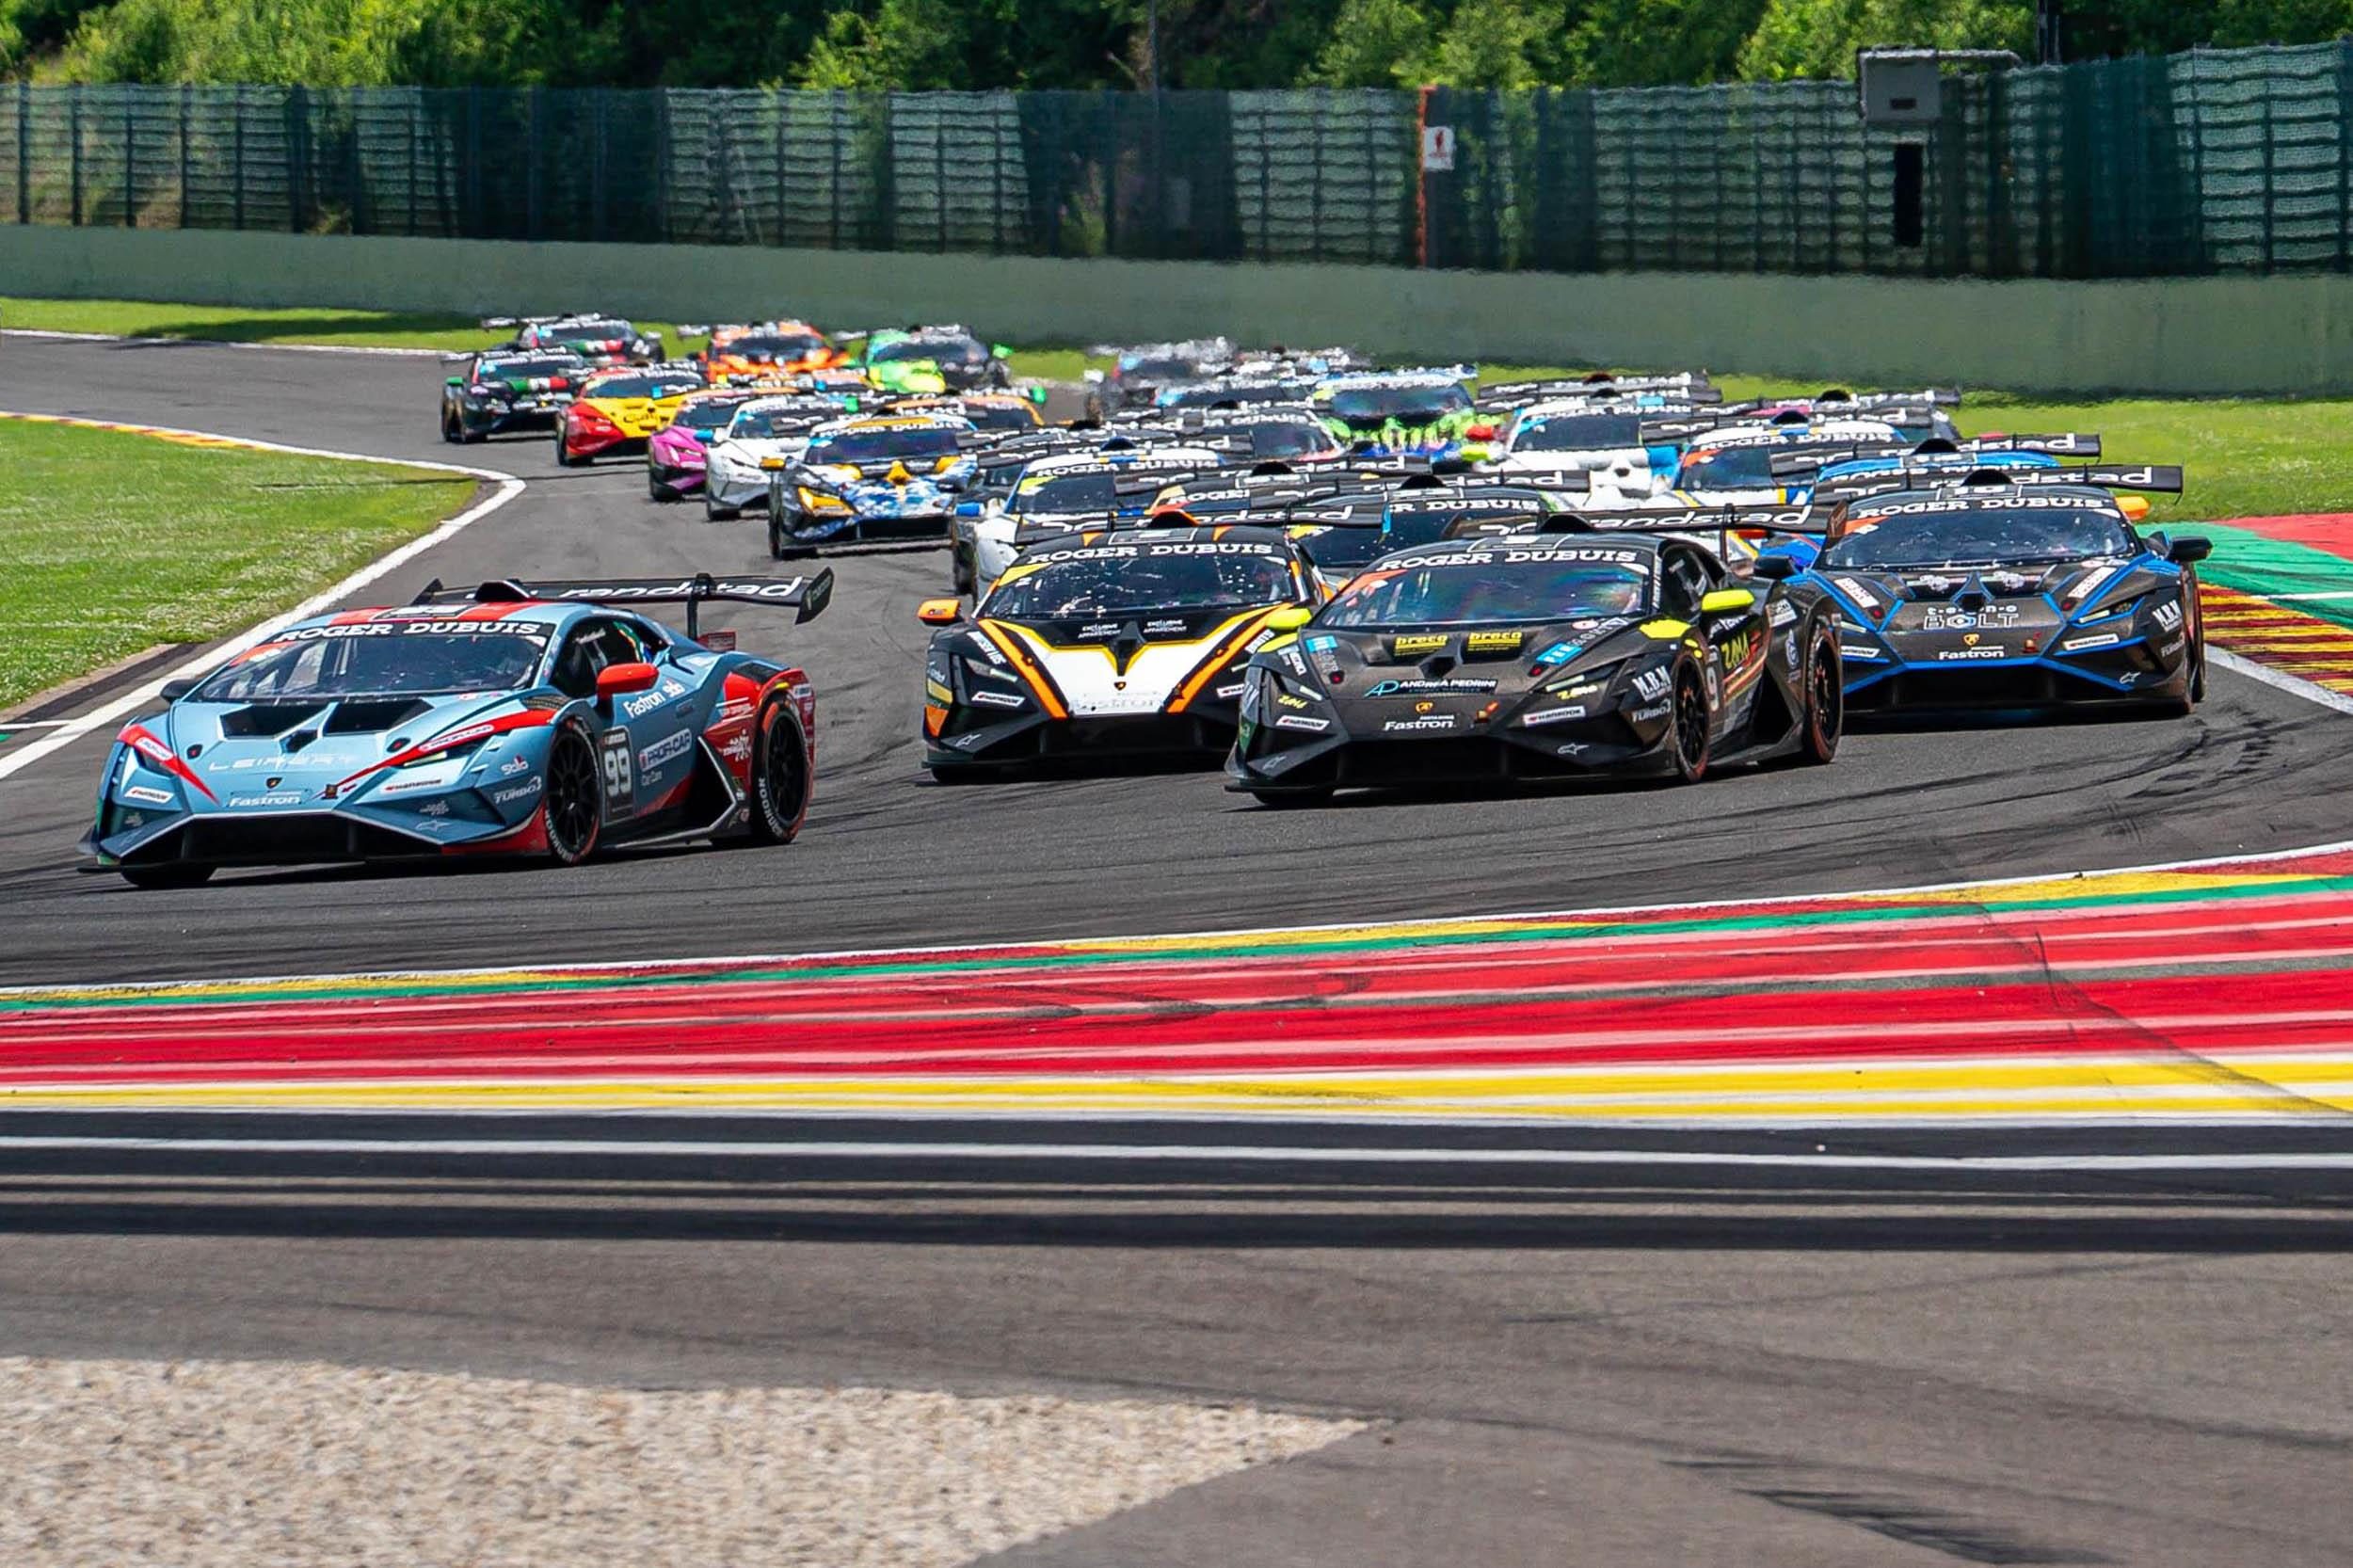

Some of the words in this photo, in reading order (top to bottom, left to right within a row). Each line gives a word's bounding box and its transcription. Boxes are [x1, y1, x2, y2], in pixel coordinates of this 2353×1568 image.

[1426, 500, 1540, 512] DUBUIS
[1857, 501, 1970, 518] ROGER
[1981, 498, 2105, 510] DUBUIS
[1027, 546, 1138, 565] ROGER
[1150, 543, 1273, 556] DUBUIS
[1376, 552, 1493, 571] ROGER
[1505, 550, 1638, 563] DUBUIS
[273, 621, 392, 643] ROGER
[403, 621, 540, 635] DUBUIS
[1923, 613, 2020, 631] BOLT
[1939, 649, 2005, 660] Fastron
[623, 691, 666, 718] Fastron
[1383, 720, 1454, 731] Fastron
[603, 746, 632, 798] 99
[229, 795, 301, 808] Fastron
